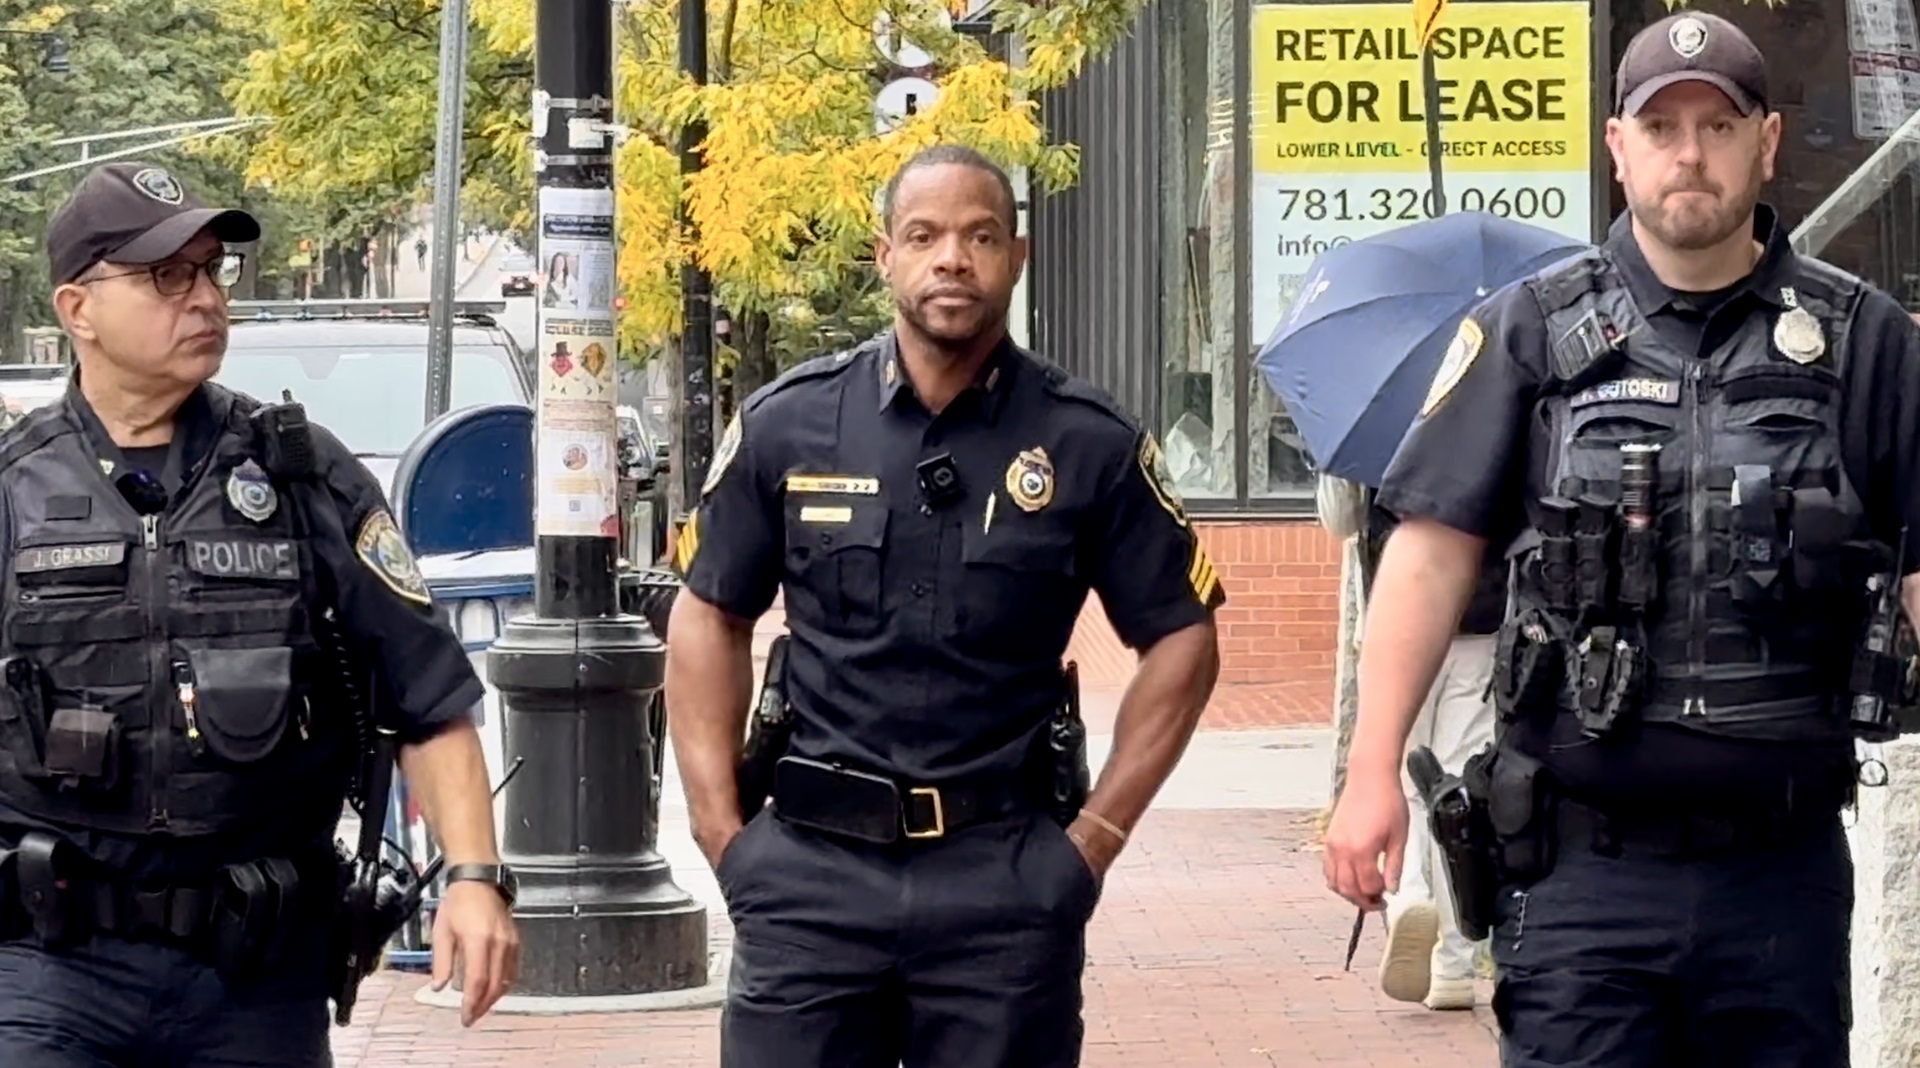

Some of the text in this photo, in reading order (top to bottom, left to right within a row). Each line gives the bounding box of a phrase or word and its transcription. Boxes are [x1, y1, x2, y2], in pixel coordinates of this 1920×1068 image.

[1276, 26, 1565, 61] RETAIL SPACE
[1276, 78, 1566, 123] FOR LEASE
[1276, 142, 1341, 158] LOWER
[1345, 141, 1402, 158] LEVEL
[1420, 140, 1487, 157] DRECT
[1492, 140, 1566, 157] ACCESS
[1278, 187, 1566, 221] 781.3200600
[194, 541, 293, 576] POLICE
